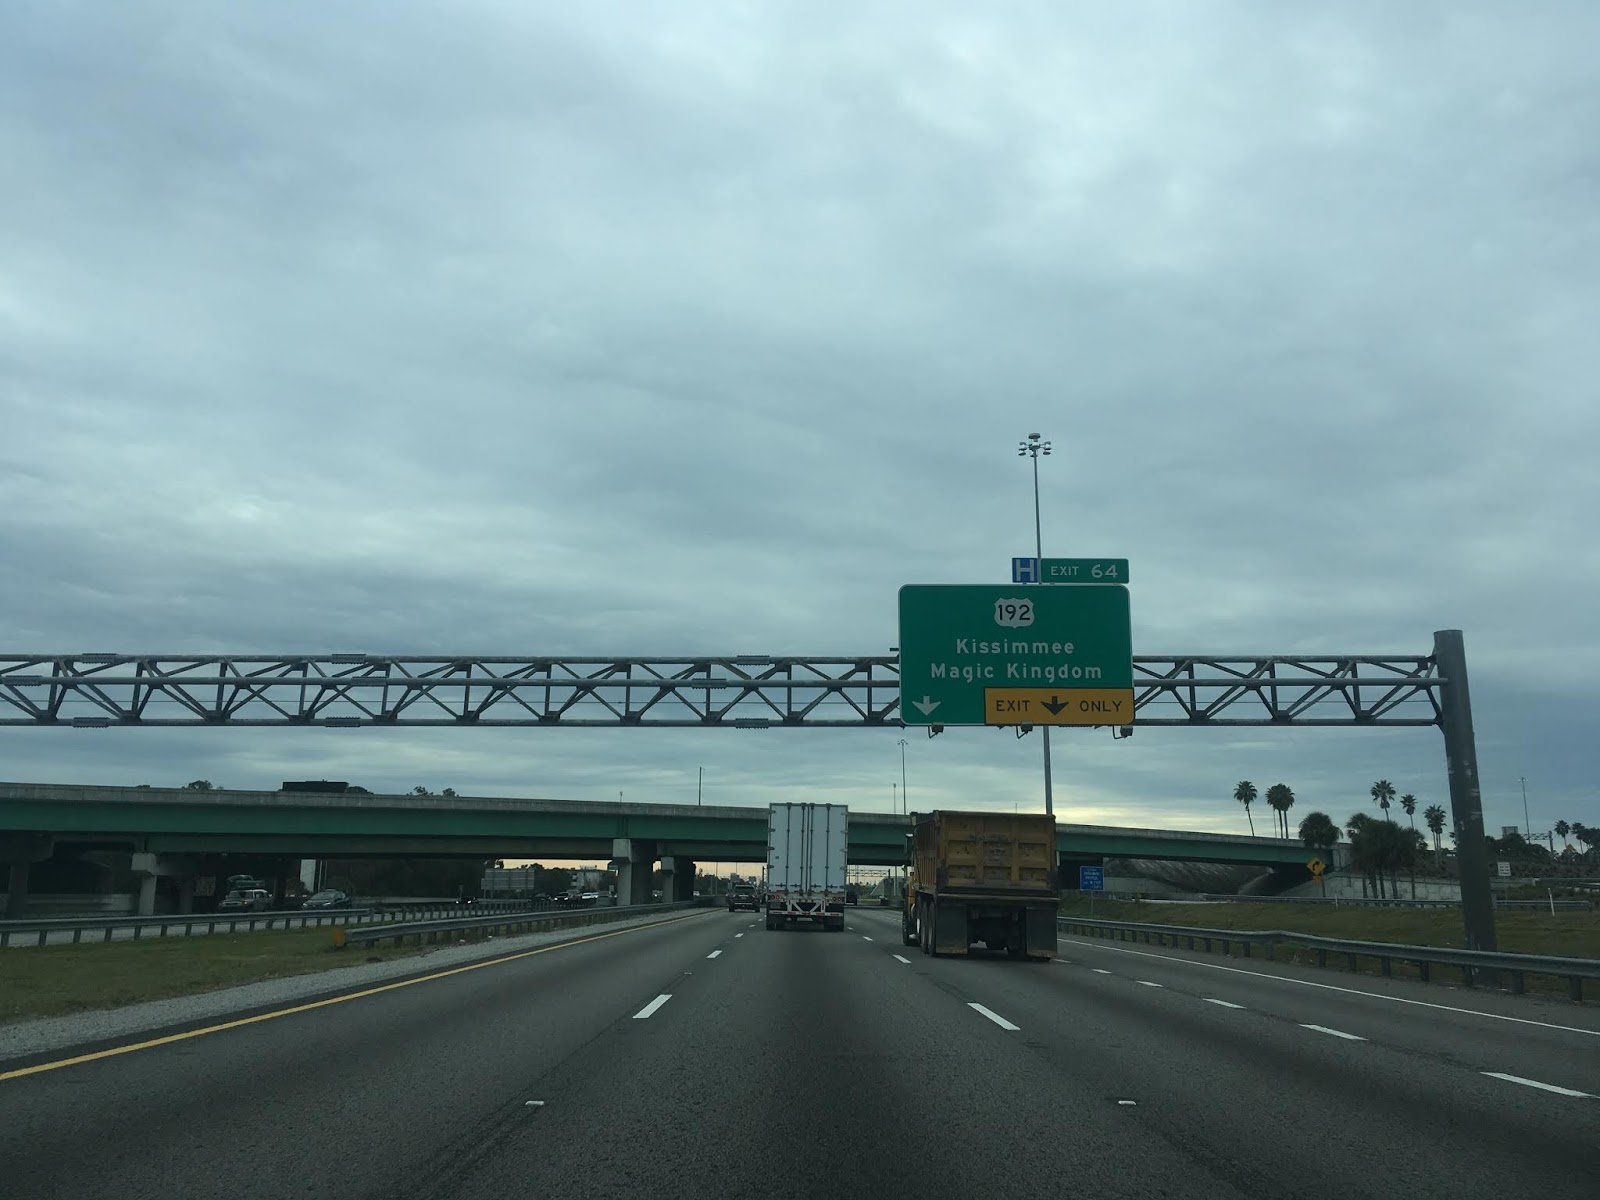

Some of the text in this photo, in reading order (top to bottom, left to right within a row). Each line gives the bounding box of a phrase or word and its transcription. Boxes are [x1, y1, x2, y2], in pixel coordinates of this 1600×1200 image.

[1050, 564, 1118, 578] EXIT 64
[998, 604, 1030, 621] 192
[956, 639, 1075, 654] Kissimmee
[931, 663, 1102, 683] Magic Kingdom
[996, 700, 1122, 712] EXIT ONLY
